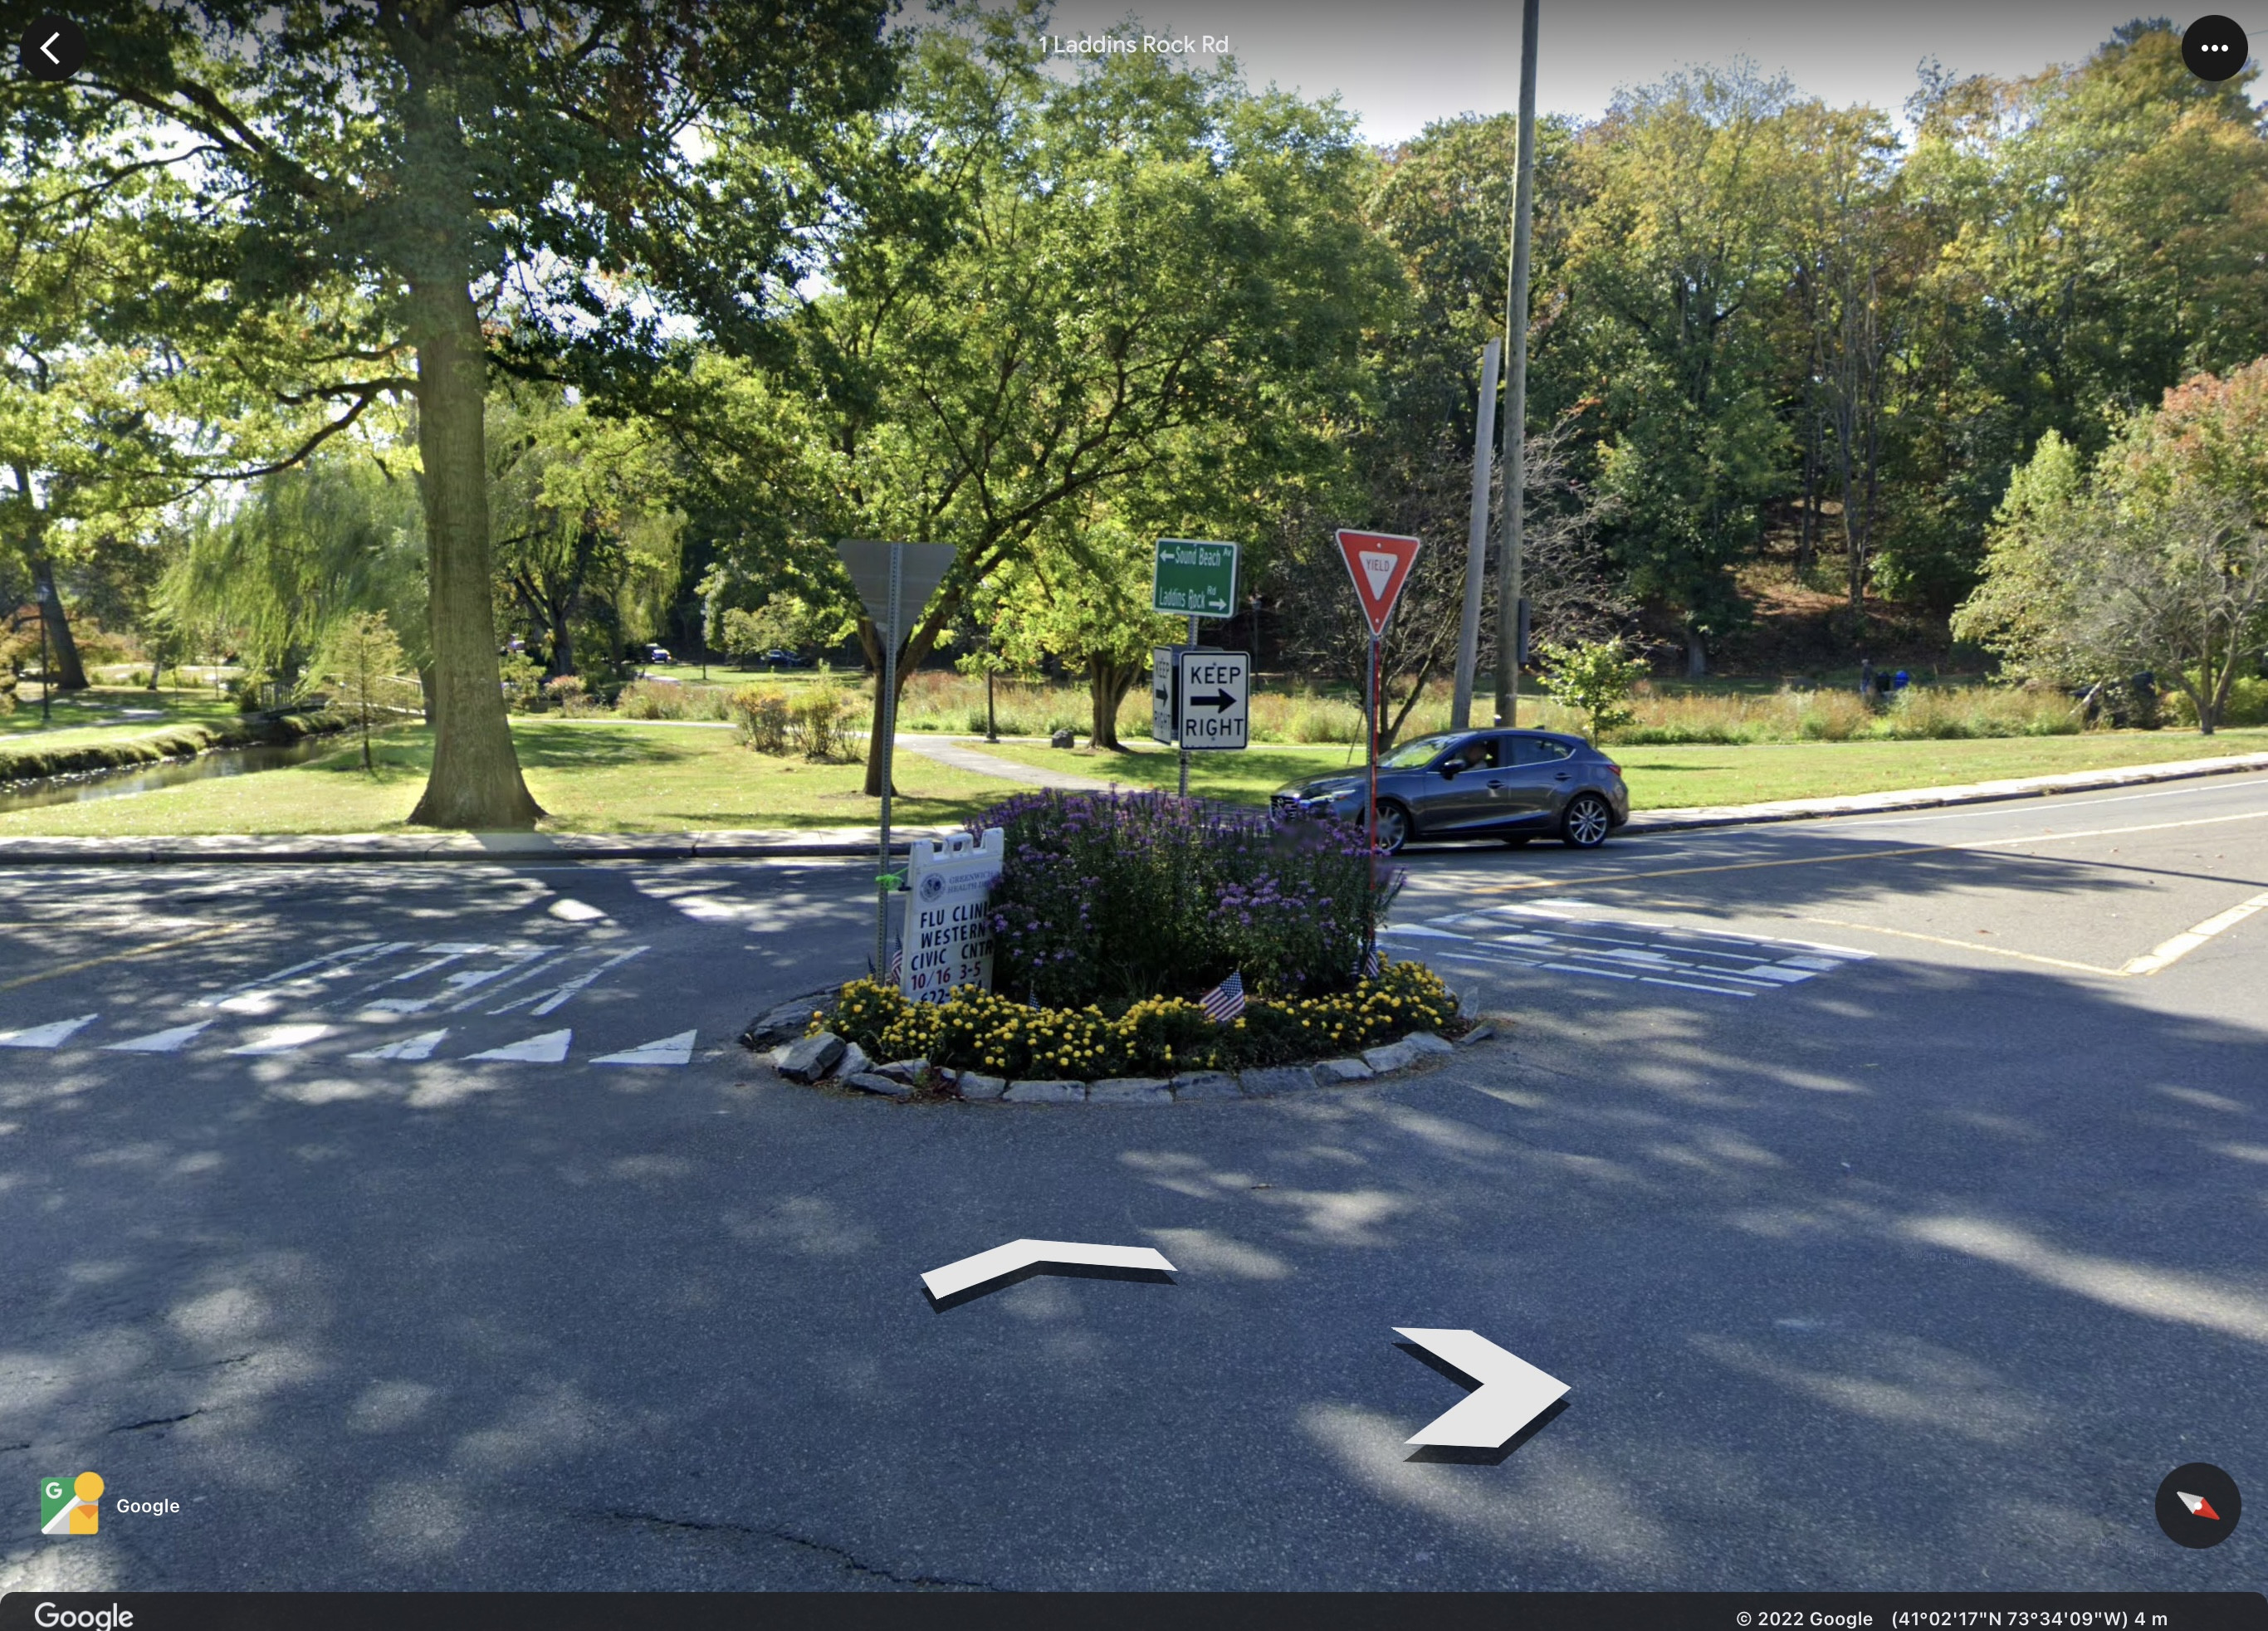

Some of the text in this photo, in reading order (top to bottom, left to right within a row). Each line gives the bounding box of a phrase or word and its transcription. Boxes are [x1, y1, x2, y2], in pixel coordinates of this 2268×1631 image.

[1176, 545, 1232, 566] Sound Beach Av
[1366, 559, 1390, 572] YIELD
[1159, 585, 1217, 609] Laddins Rock Rd
[1190, 667, 1241, 684] KEEP
[1185, 718, 1244, 736] RIGHT
[948, 881, 977, 894] HEALTH
[949, 870, 995, 885] GREENWICH
[921, 901, 988, 929] FLU CLINI
[921, 922, 985, 949] WESTERN
[911, 939, 994, 971] CIVIC CNTR
[911, 961, 981, 991] 10/16 3-5
